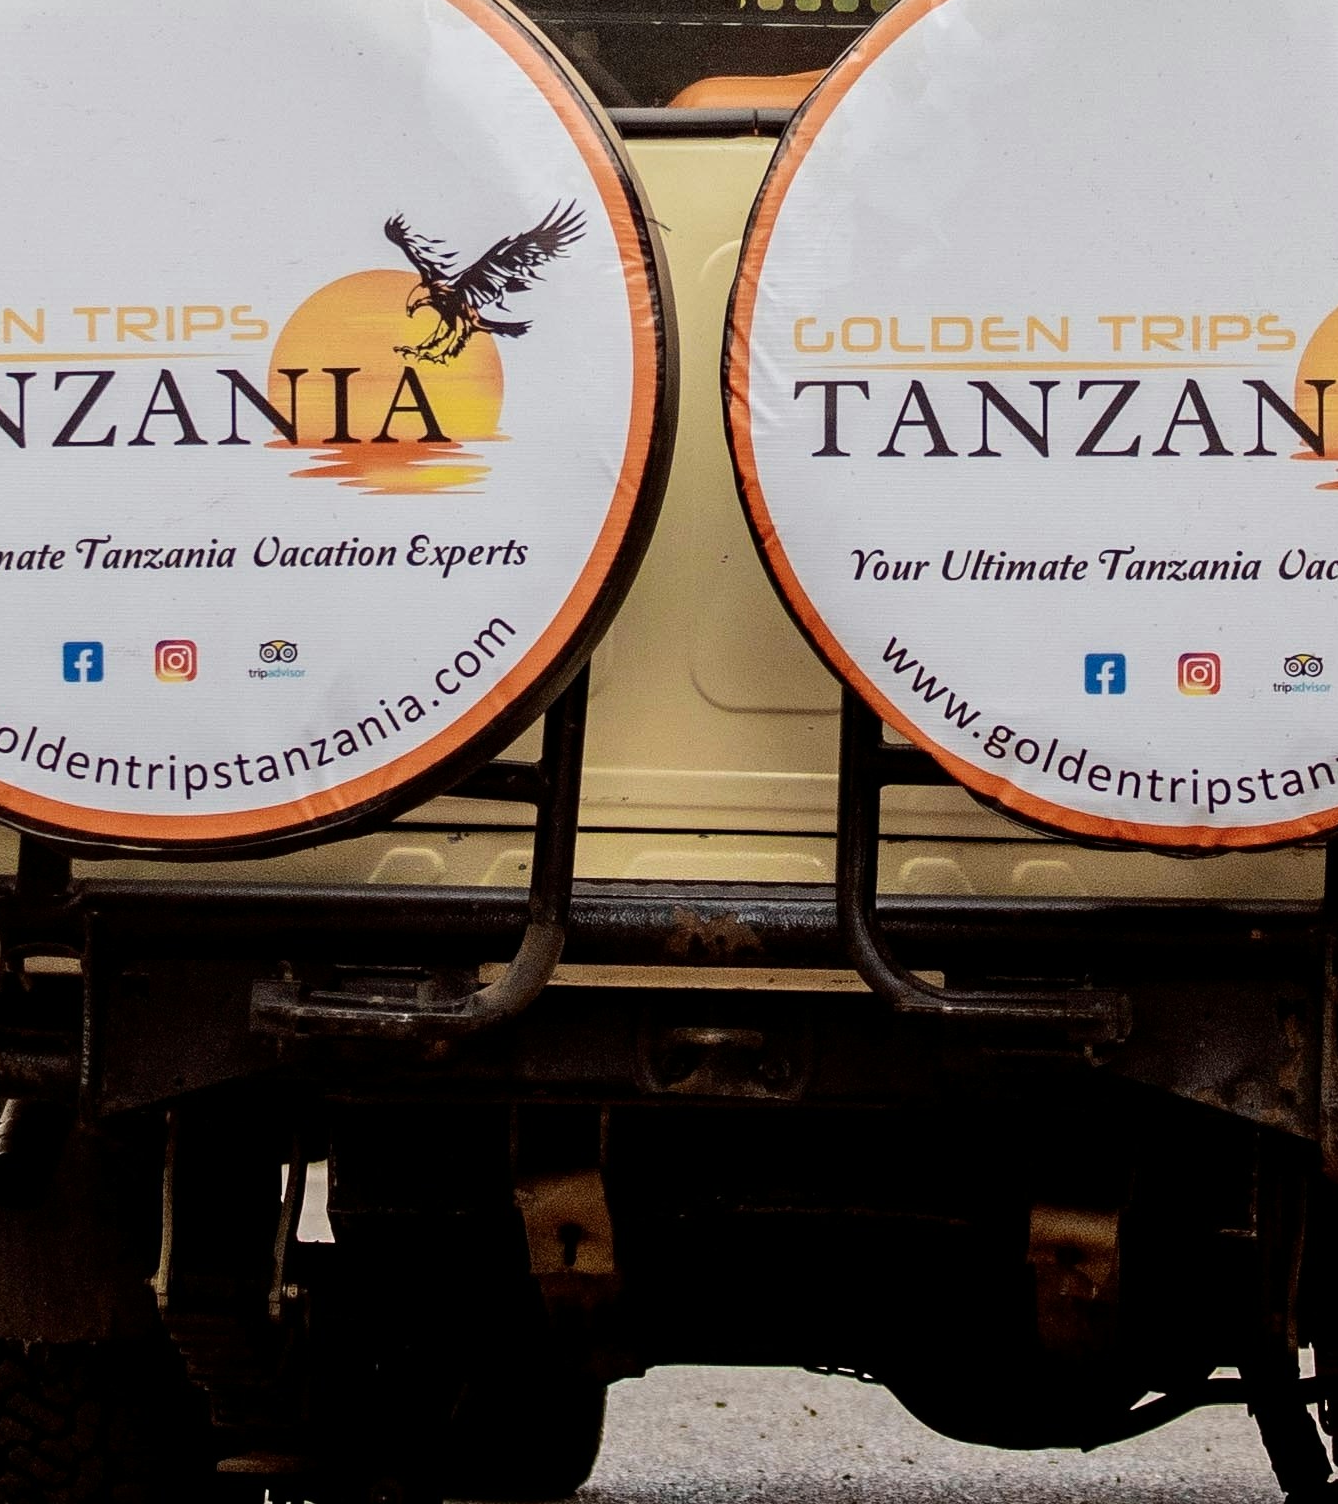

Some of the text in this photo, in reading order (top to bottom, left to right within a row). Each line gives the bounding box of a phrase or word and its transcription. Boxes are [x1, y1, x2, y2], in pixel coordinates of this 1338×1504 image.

[73, 304, 270, 343] TRIPS
[794, 312, 1297, 354] GOLDEN TRIPS
[75, 537, 237, 571] Tanzania
[252, 537, 398, 568] Vacation
[406, 534, 529, 578] Experts
[851, 549, 929, 583] Your
[941, 549, 1089, 582] Ultimate
[1098, 548, 1261, 581] Tanzania
[248, 668, 306, 679] tripadvisor
[1273, 682, 1332, 695] tripadvisor
